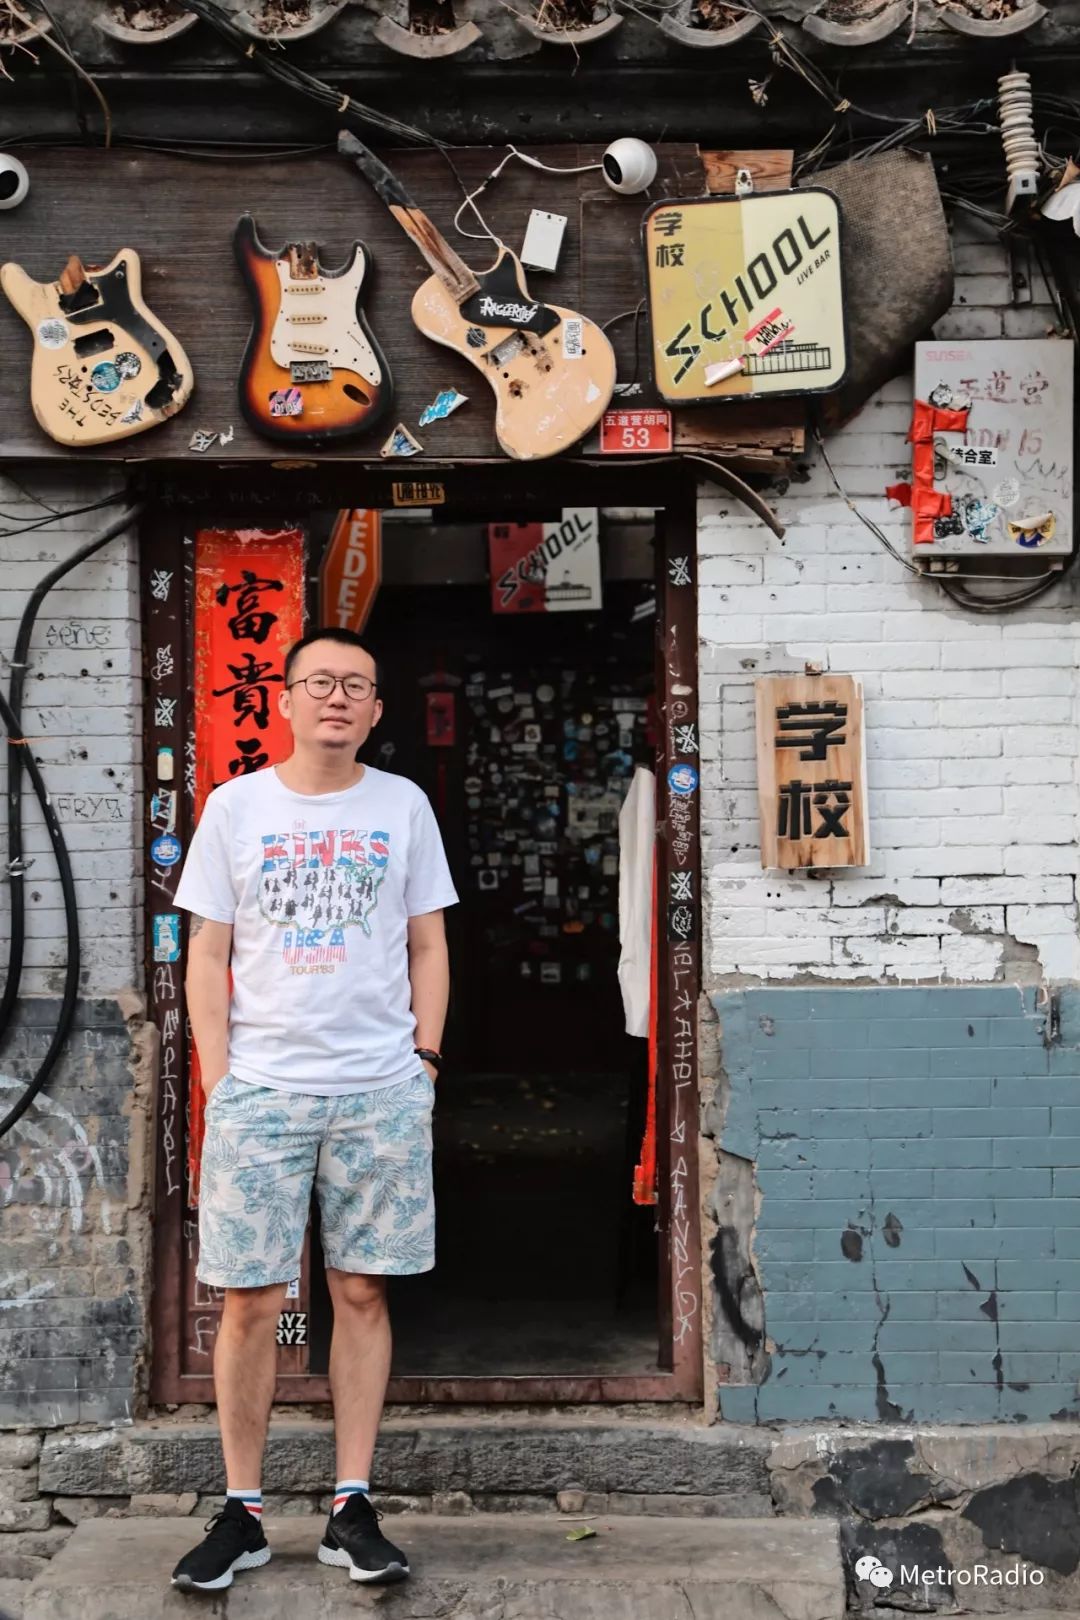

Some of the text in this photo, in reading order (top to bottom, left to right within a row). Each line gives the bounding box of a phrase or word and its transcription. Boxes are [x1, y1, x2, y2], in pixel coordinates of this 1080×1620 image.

[654, 212, 685, 268] 学校
[797, 249, 831, 286] LIVE BAR
[665, 215, 830, 384] SCHOOL
[622, 427, 650, 448] 53
[496, 513, 592, 608] SCHOOL
[774, 700, 854, 840] 学校
[261, 829, 391, 873] KINKS
